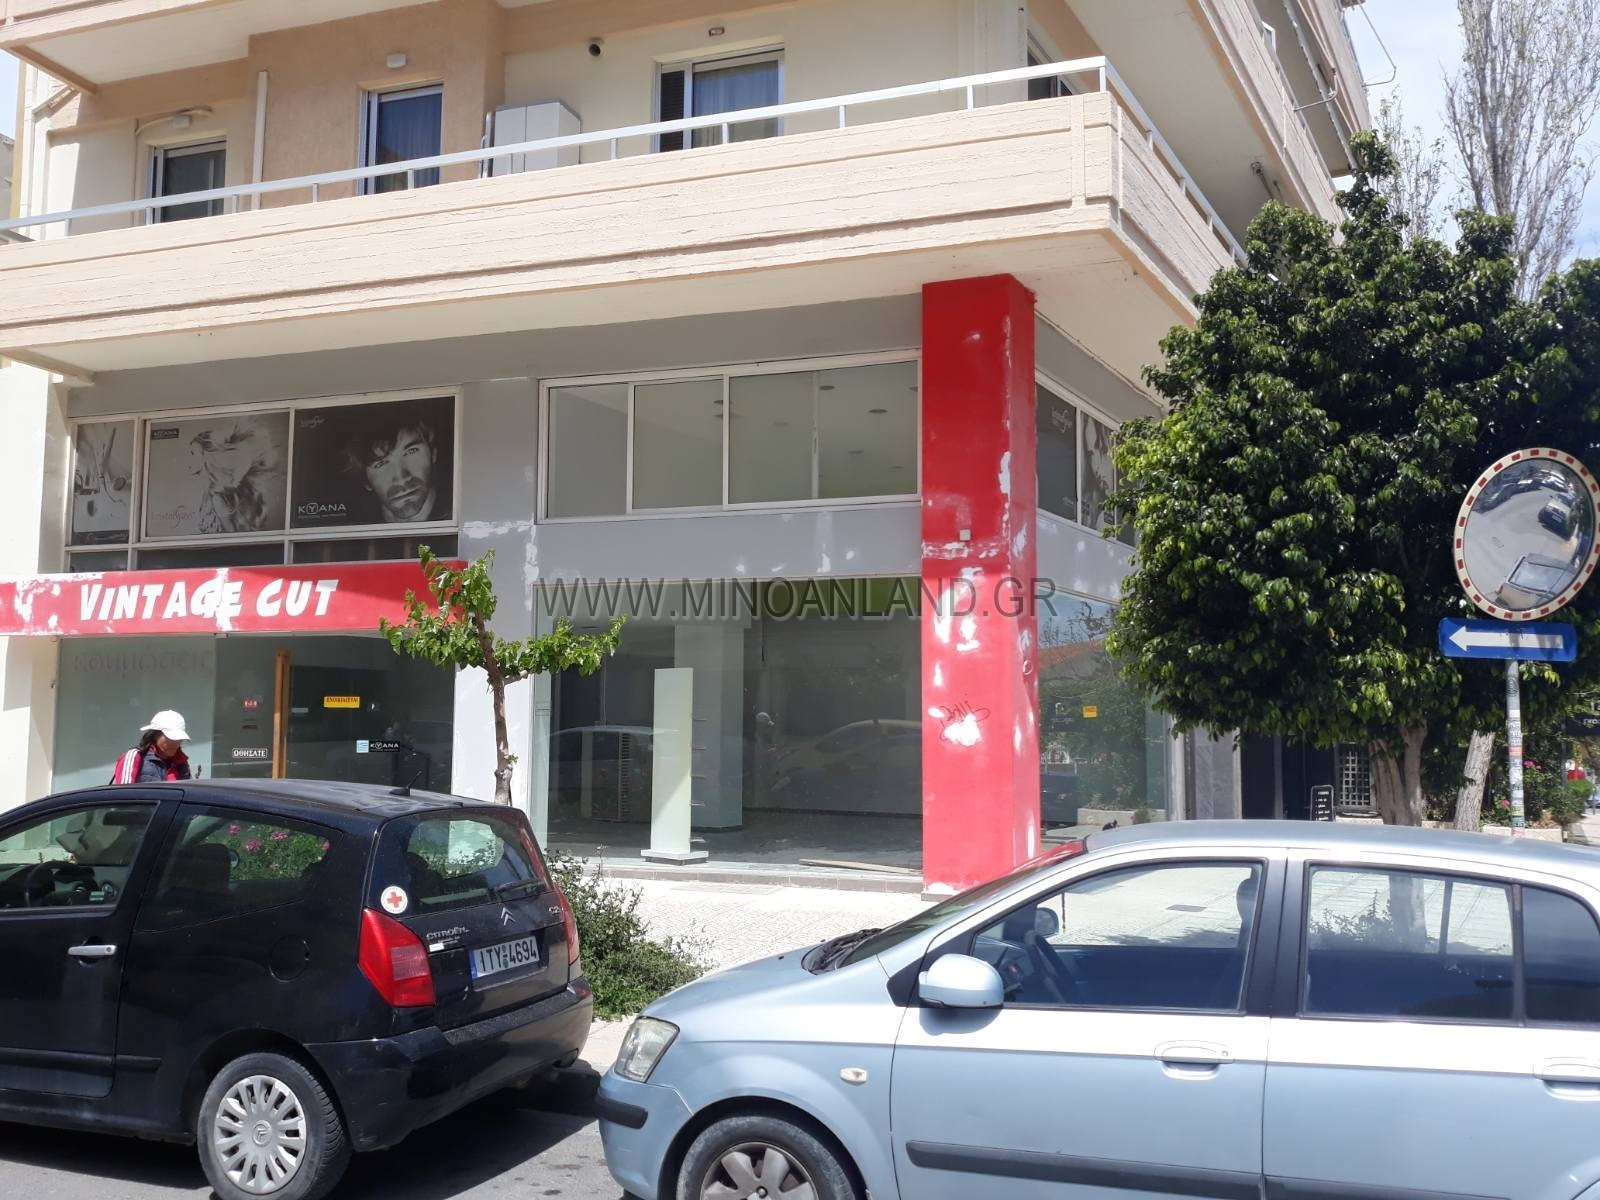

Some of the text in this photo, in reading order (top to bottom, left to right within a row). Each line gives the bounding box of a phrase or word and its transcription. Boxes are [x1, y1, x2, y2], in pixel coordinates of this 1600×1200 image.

[298, 502, 346, 514] KYANA
[80, 578, 339, 621] VINTAGE CUT
